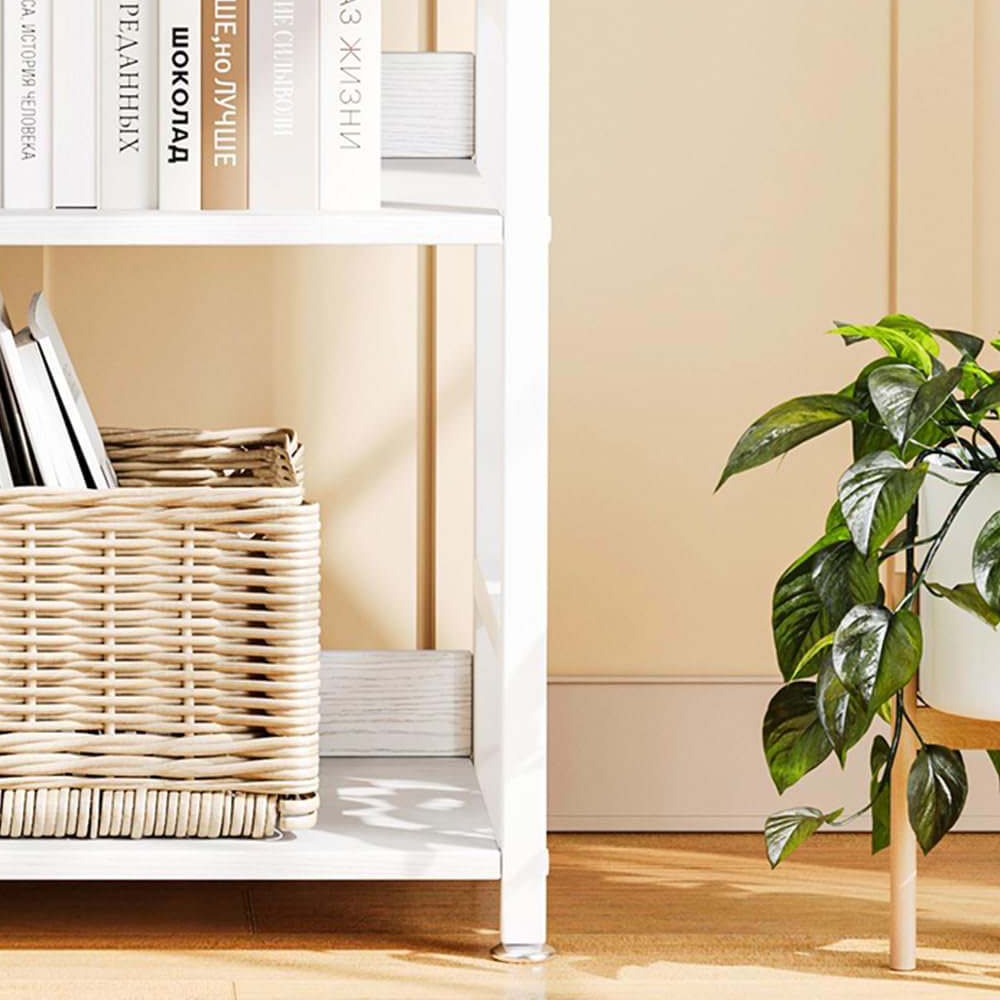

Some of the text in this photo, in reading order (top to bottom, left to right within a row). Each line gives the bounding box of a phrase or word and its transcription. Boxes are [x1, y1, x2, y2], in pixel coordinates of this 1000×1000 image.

[21, 24, 37, 87] ИСТОРИЯ
[167, 27, 190, 164] ШОКОЛАД
[339, 36, 362, 149] ЖИЗНИ
[21, 90, 37, 161] ЧЕЛОВЕКА
[214, 77, 237, 167] ЛУЧШЕ
